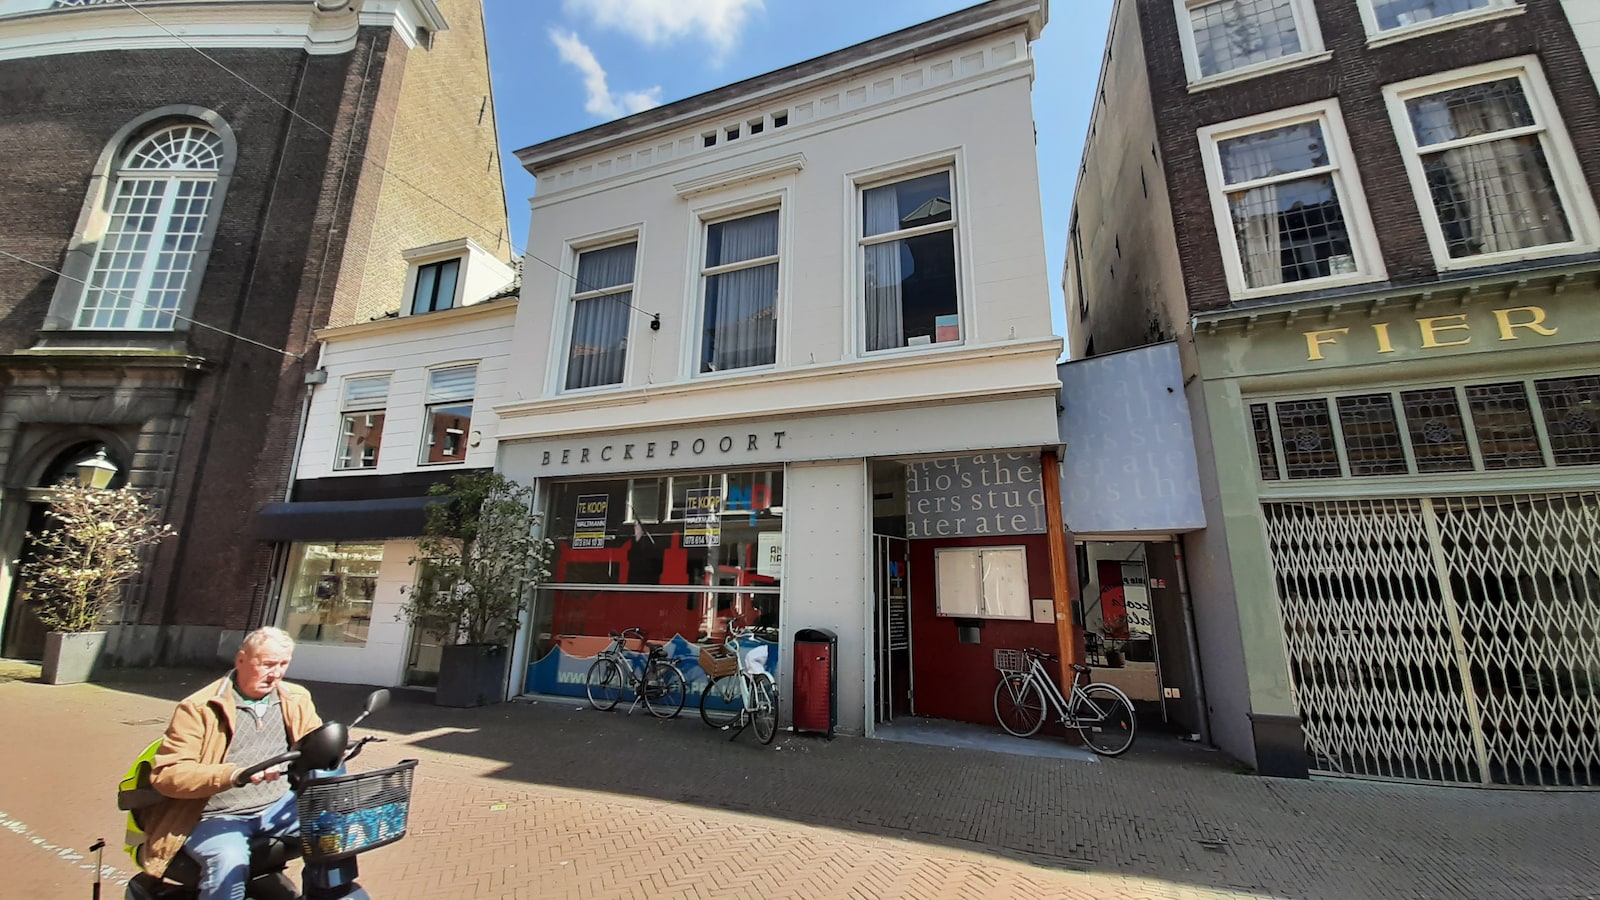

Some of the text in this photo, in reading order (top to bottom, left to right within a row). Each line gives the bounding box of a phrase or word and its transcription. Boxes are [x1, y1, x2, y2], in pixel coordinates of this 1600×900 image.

[1302, 305, 1558, 361] FIER
[541, 431, 786, 466] BERCKEPOORT
[578, 501, 607, 513] TE KOOP
[687, 496, 720, 509] TE KOOP
